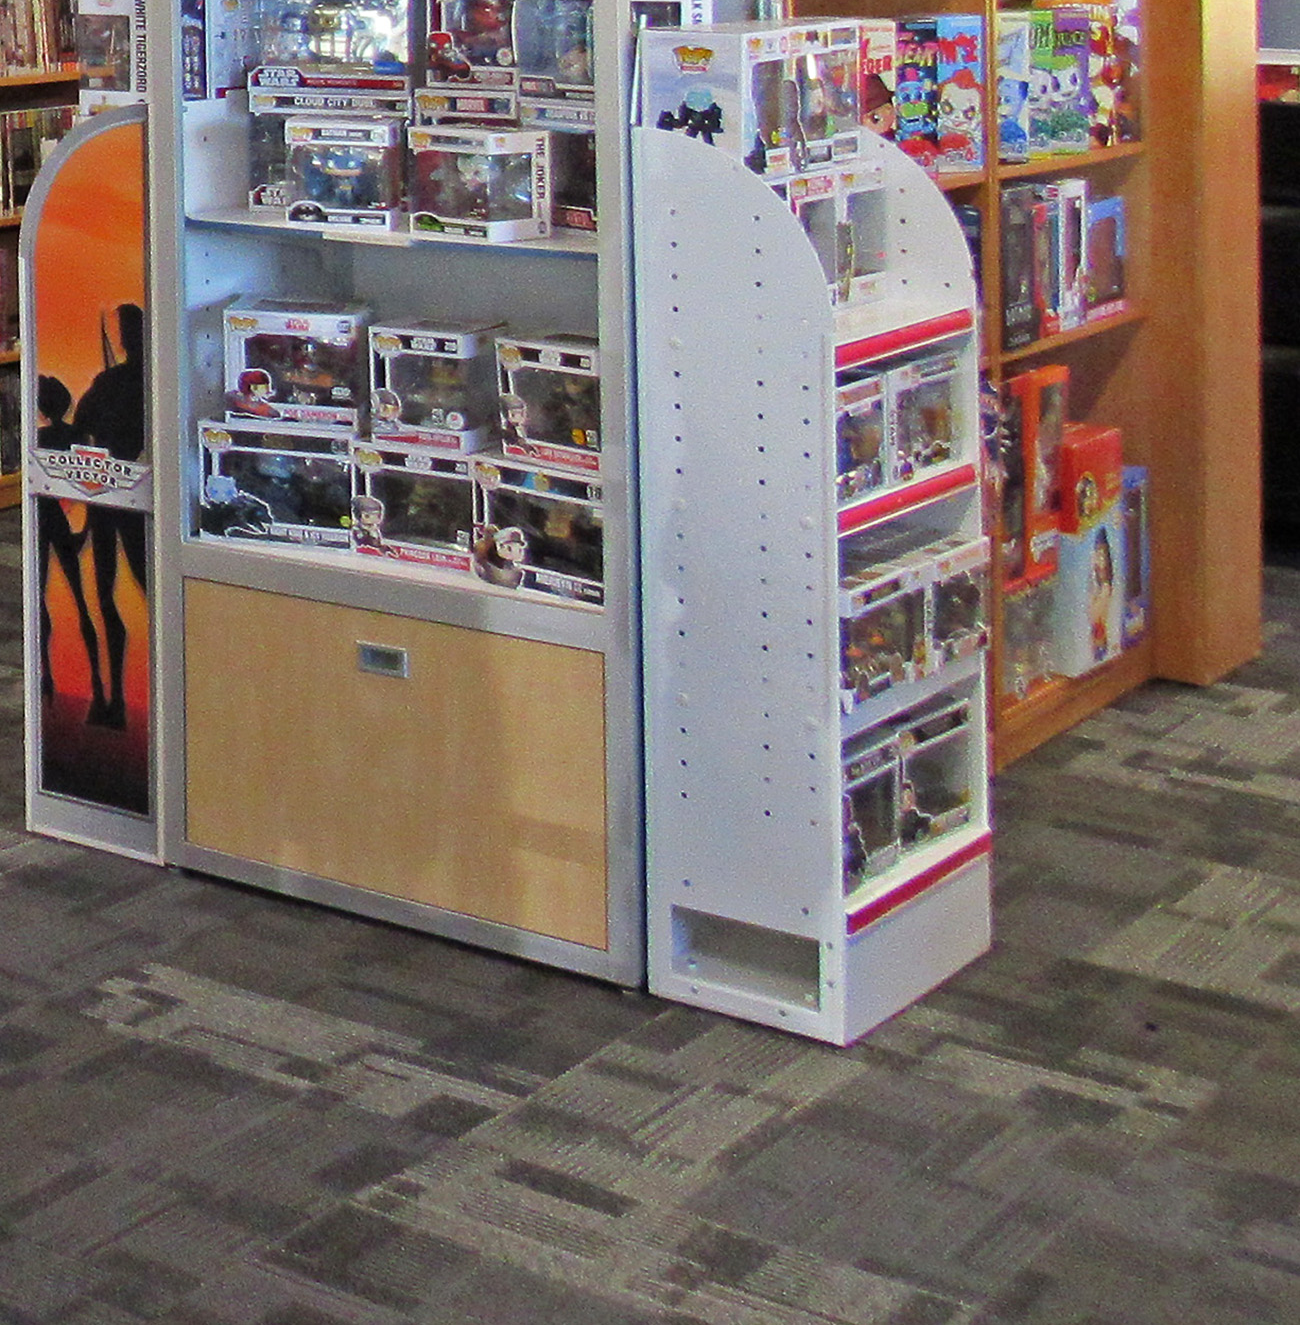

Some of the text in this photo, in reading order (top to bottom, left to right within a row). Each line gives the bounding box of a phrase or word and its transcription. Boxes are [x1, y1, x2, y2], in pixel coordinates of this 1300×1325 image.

[135, 35, 146, 92] TIGERZORD
[48, 454, 131, 476] COLLECTOR
[66, 470, 117, 486] VECTOR
